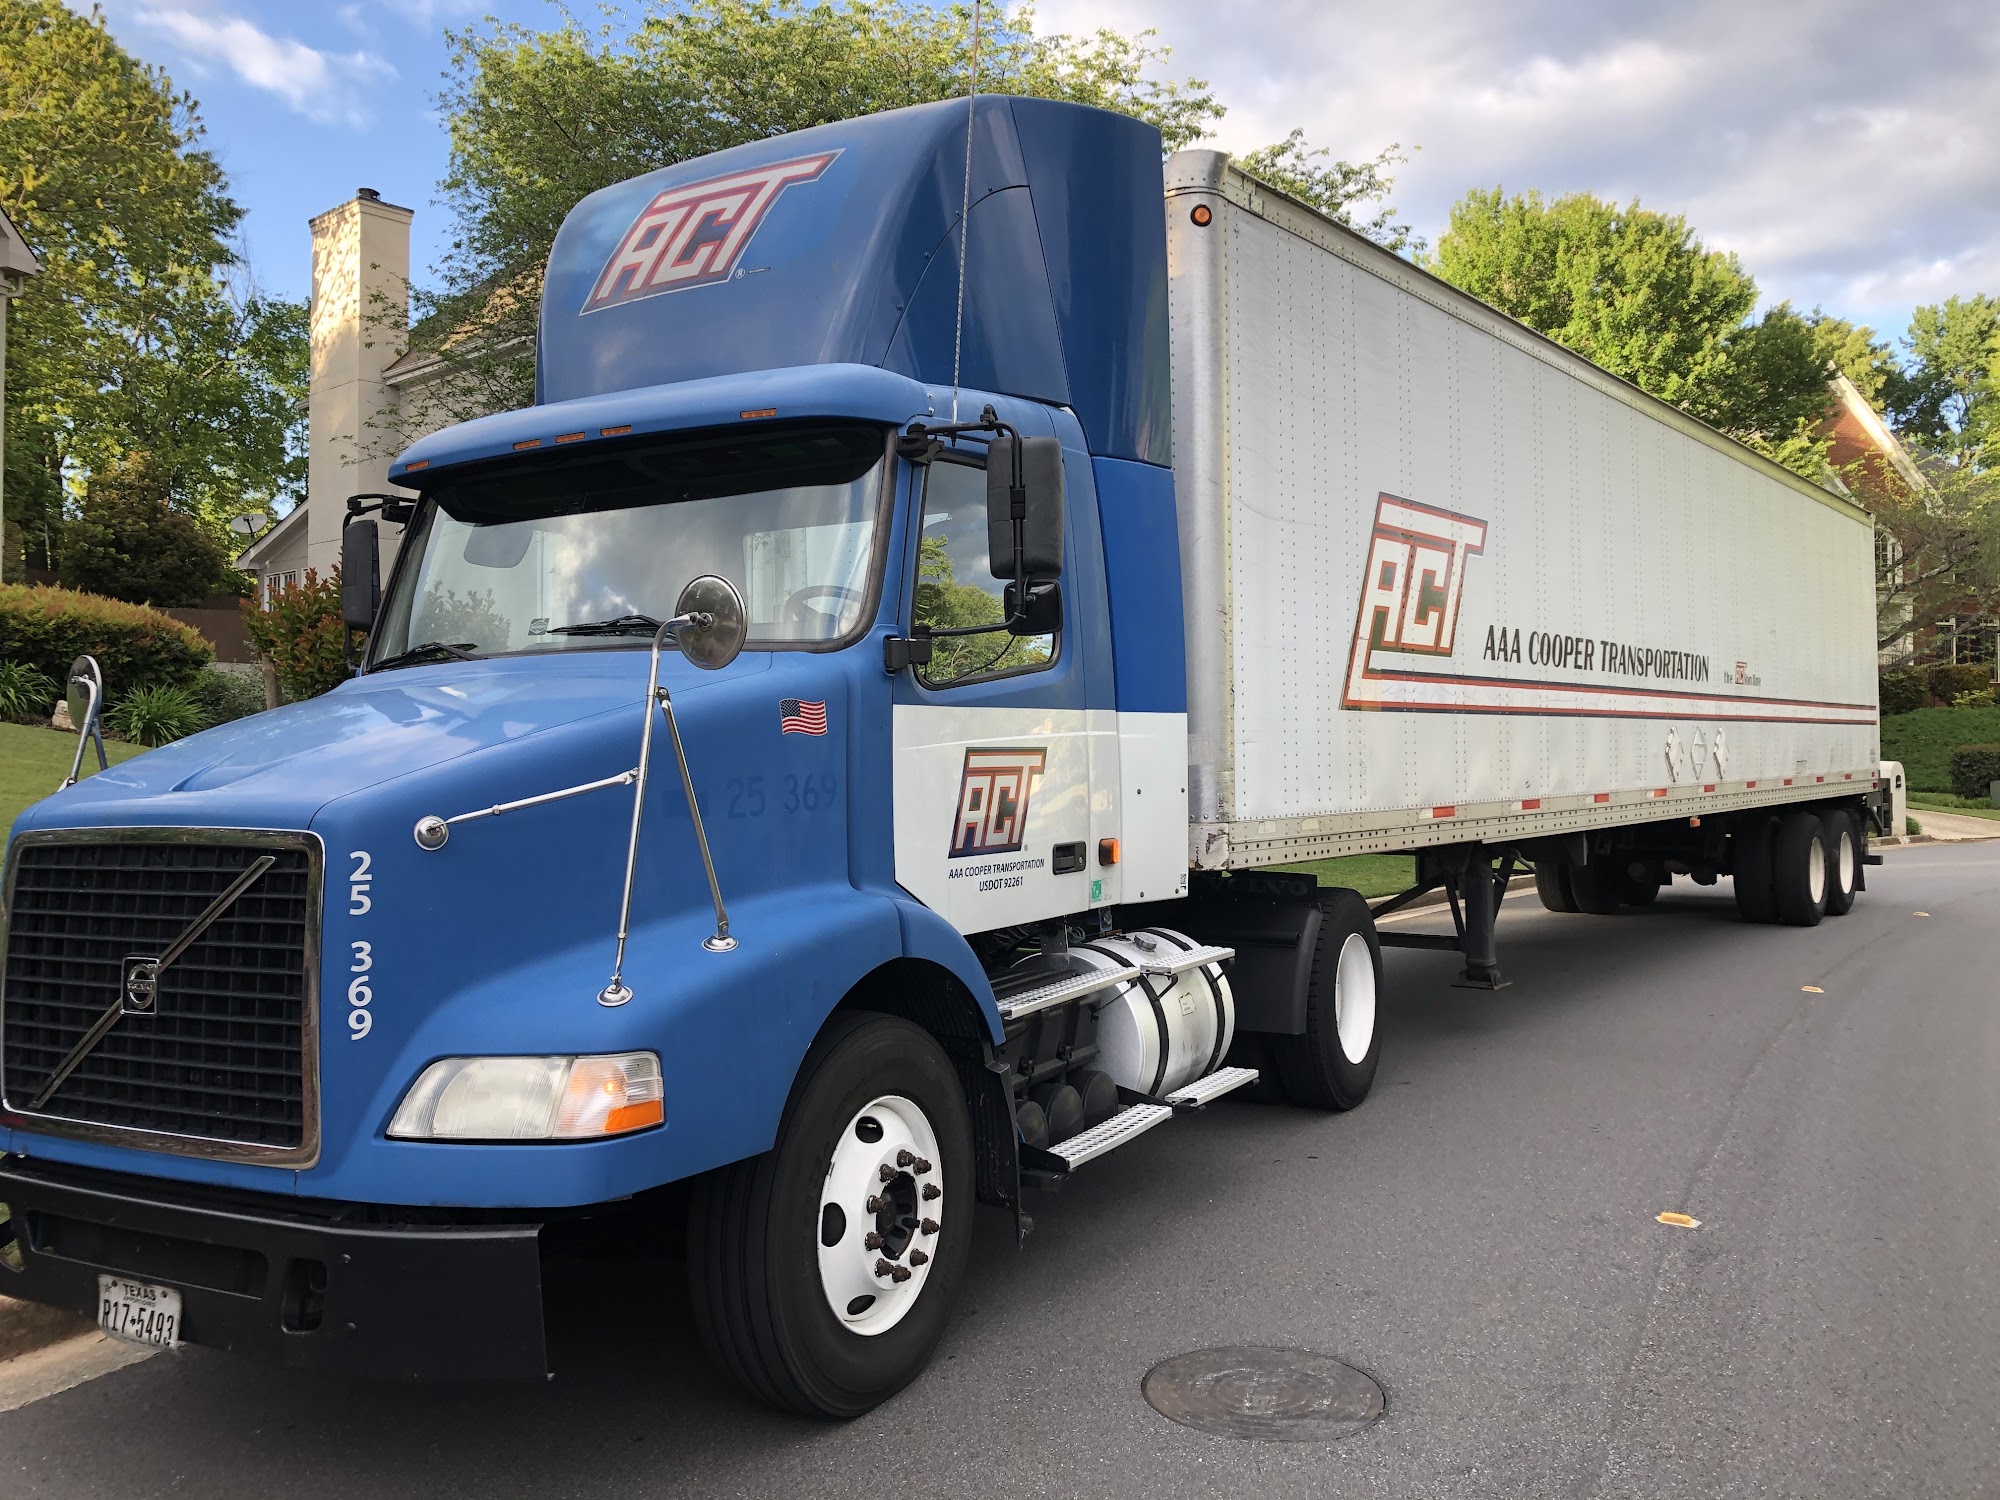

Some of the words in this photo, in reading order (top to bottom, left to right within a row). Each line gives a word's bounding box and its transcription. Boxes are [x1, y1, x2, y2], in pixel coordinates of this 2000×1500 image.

[586, 151, 841, 306] ACT
[1350, 491, 1488, 658] ACT
[1483, 624, 1521, 663] AAA
[1528, 630, 1594, 671] COOPER
[1600, 640, 1709, 683] TRANSPORTATION
[726, 774, 766, 819] 25
[783, 769, 837, 814] 369
[949, 747, 1047, 858] ACT
[348, 850, 373, 916] 25
[949, 868, 964, 879] AAA
[965, 864, 992, 877] COOPER
[993, 858, 1045, 874] TRANSPORTATION
[979, 879, 1004, 892] USDOT
[1004, 876, 1024, 889] 92261
[347, 940, 373, 1041] 369
[122, 1284, 156, 1301] TEXAS
